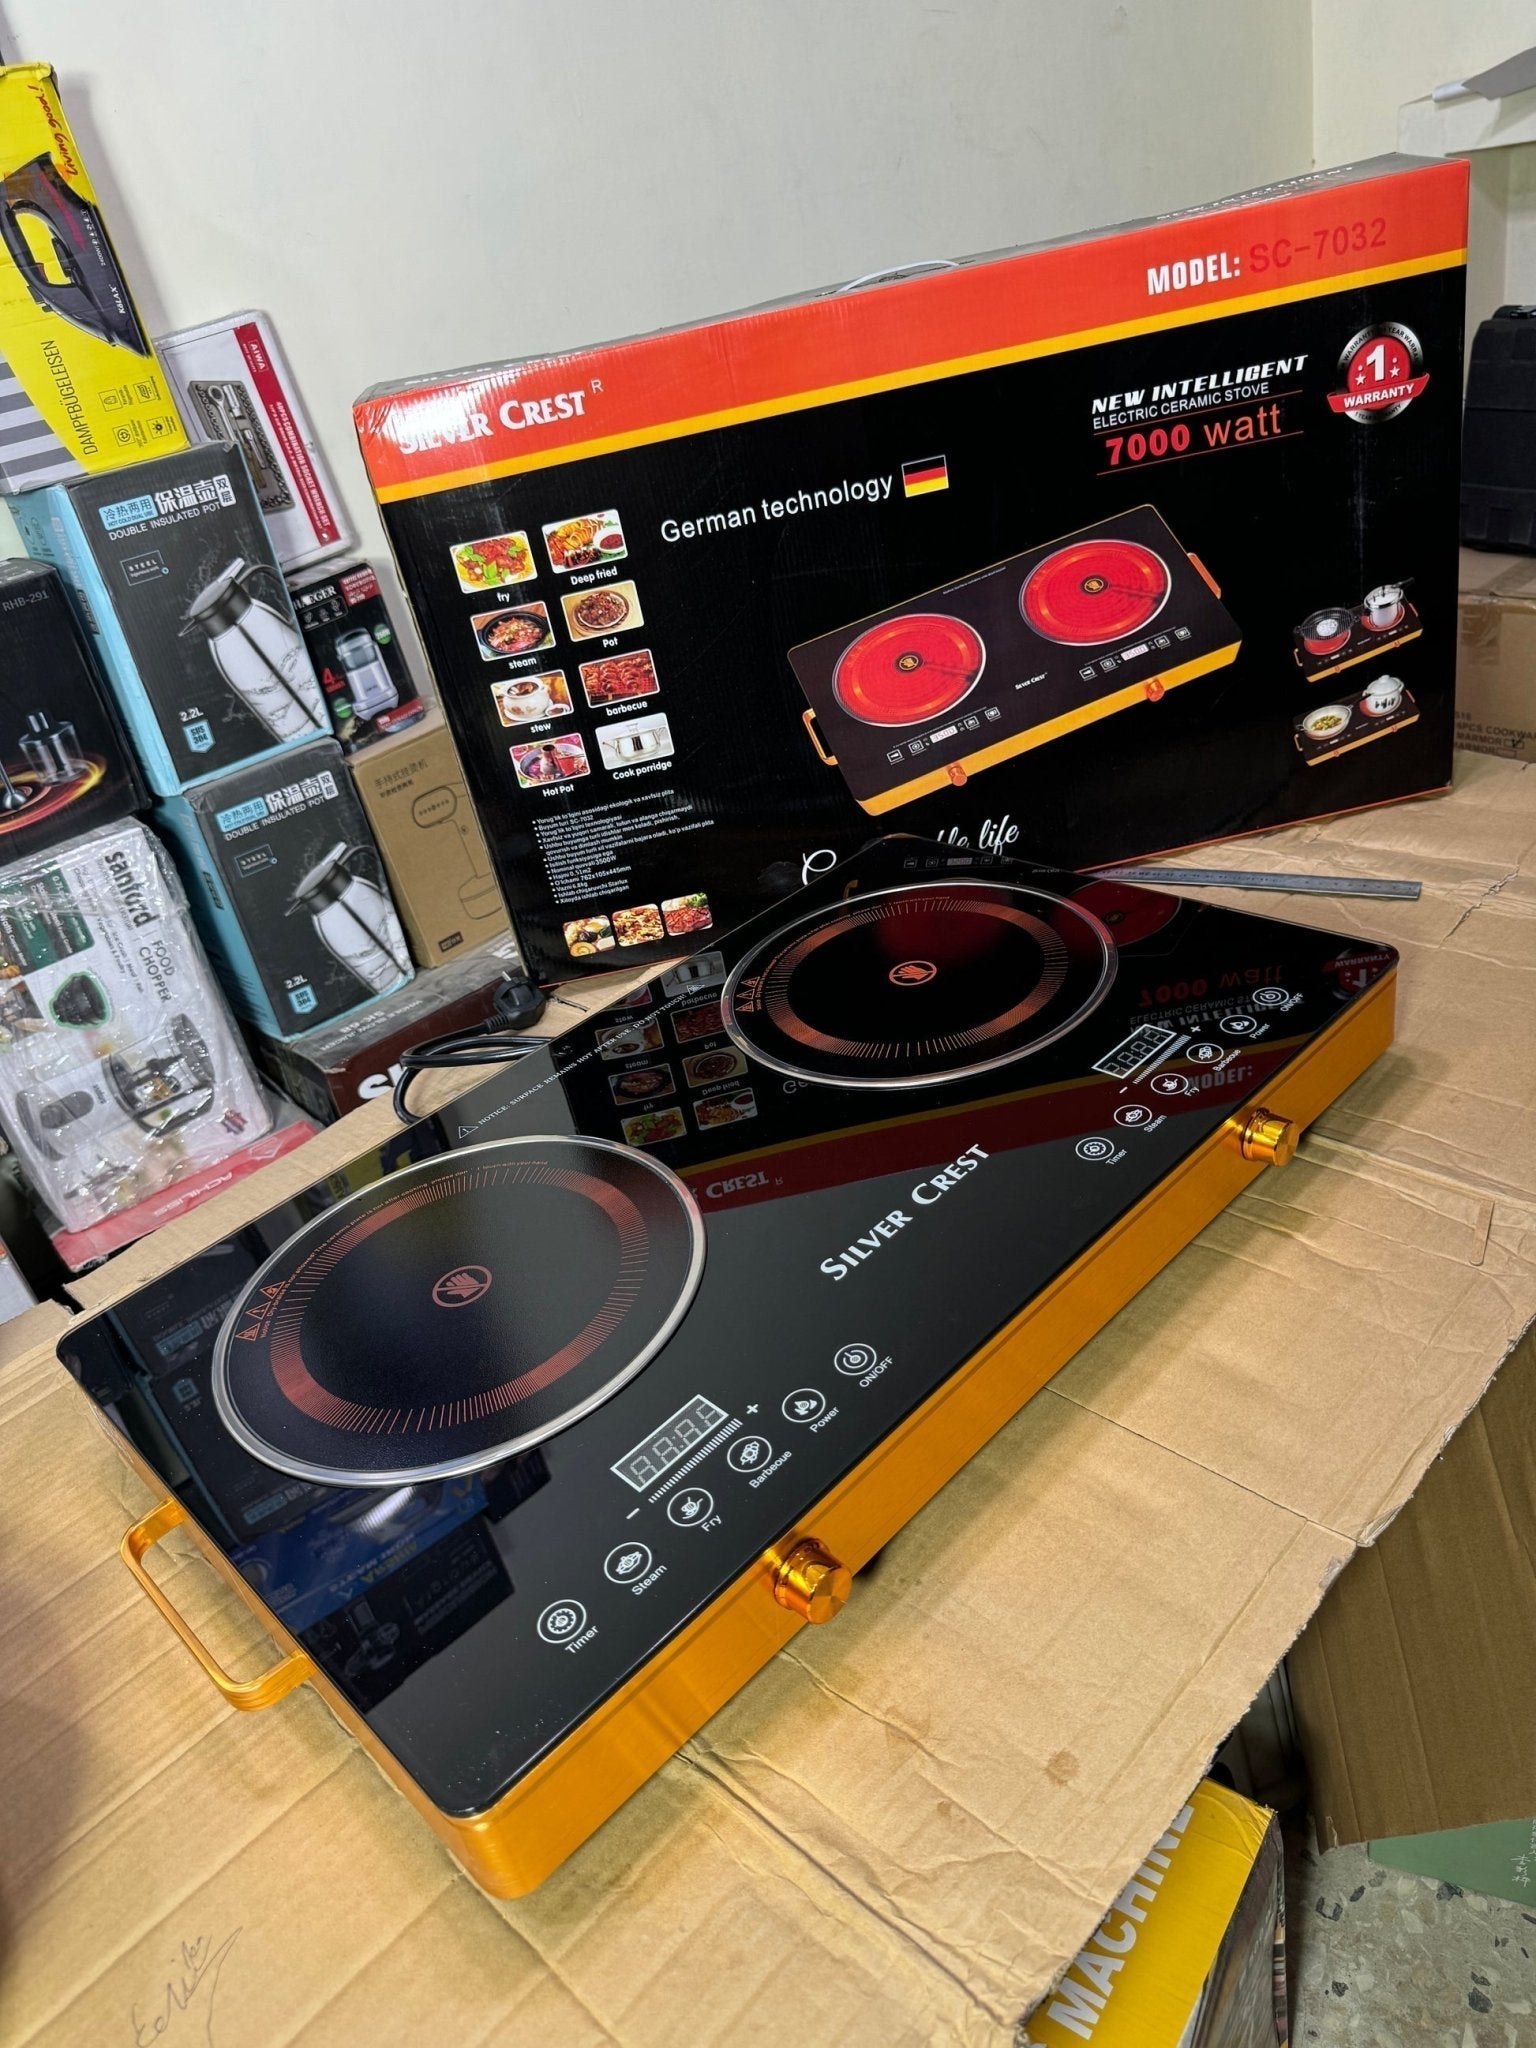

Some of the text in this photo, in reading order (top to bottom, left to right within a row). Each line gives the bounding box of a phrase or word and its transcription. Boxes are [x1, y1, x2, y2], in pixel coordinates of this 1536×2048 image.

[54, 132, 79, 177] Living
[1146, 217, 1387, 295] MODEL: SC-7032
[249, 341, 266, 369] AIWA
[1343, 329, 1373, 361] WARRANT
[1366, 344, 1385, 382] 1
[41, 340, 98, 455] DAMPFBÜGELEISEN
[1091, 354, 1309, 415] NEW INTELLIGENT
[1343, 383, 1415, 408] WARRANTY
[499, 390, 585, 430] CREST
[1092, 381, 1270, 430] ELECTRIC CERAMIC STOVE
[1105, 403, 1283, 465] 7000 watt
[103, 498, 152, 521] 冷热两用
[154, 479, 218, 515] 保温壶
[300, 463, 316, 488] SOCKET
[309, 488, 326, 515] WRENCH
[320, 514, 330, 527] SET
[661, 475, 893, 542] German technology
[108, 501, 221, 541] DOUBLE INSULATED POT
[570, 566, 618, 586] Deep fried
[2, 590, 50, 612] RHB-291
[497, 591, 511, 603] fry
[602, 636, 619, 648] Pot
[508, 656, 537, 670] steam
[178, 706, 205, 721] 2.2L
[606, 700, 648, 717] barbecue
[530, 722, 551, 734] stew
[612, 759, 673, 781] Cook porridge
[265, 777, 322, 814] 保温壶
[542, 783, 575, 798] Hot Pot
[224, 822, 260, 841] DOUBLE
[262, 803, 306, 827] INSULATED
[308, 796, 325, 809] POT
[569, 814, 593, 824] SC-7032
[978, 814, 1020, 856] life
[594, 855, 617, 865] 3500W
[102, 845, 160, 928] sanford
[136, 944, 173, 1003] CHOPPER
[150, 938, 177, 977] FOOD
[1279, 991, 1304, 1013] ON/OFF
[1249, 1022, 1271, 1040] Power
[477, 1102, 510, 1126] NOTICE:
[508, 1081, 543, 1106] SURFACE
[543, 1060, 577, 1085] REMAINS
[576, 1051, 593, 1064] HOT
[593, 1036, 617, 1054] AFTER
[632, 1018, 645, 1029] DO
[644, 1008, 660, 1021] NOT
[659, 992, 686, 1012] TOUCH!
[1184, 1086, 1200, 1098] Fry
[1143, 1114, 1168, 1133] Steam
[1105, 1148, 1128, 1166] Timer
[819, 1143, 991, 1282] SILVER CREST
[858, 1355, 894, 1388] ON/OFF
[809, 1405, 840, 1433] Power
[701, 1513, 723, 1532] Fry
[631, 1562, 668, 1596] Steam
[564, 1623, 599, 1655] Timer
